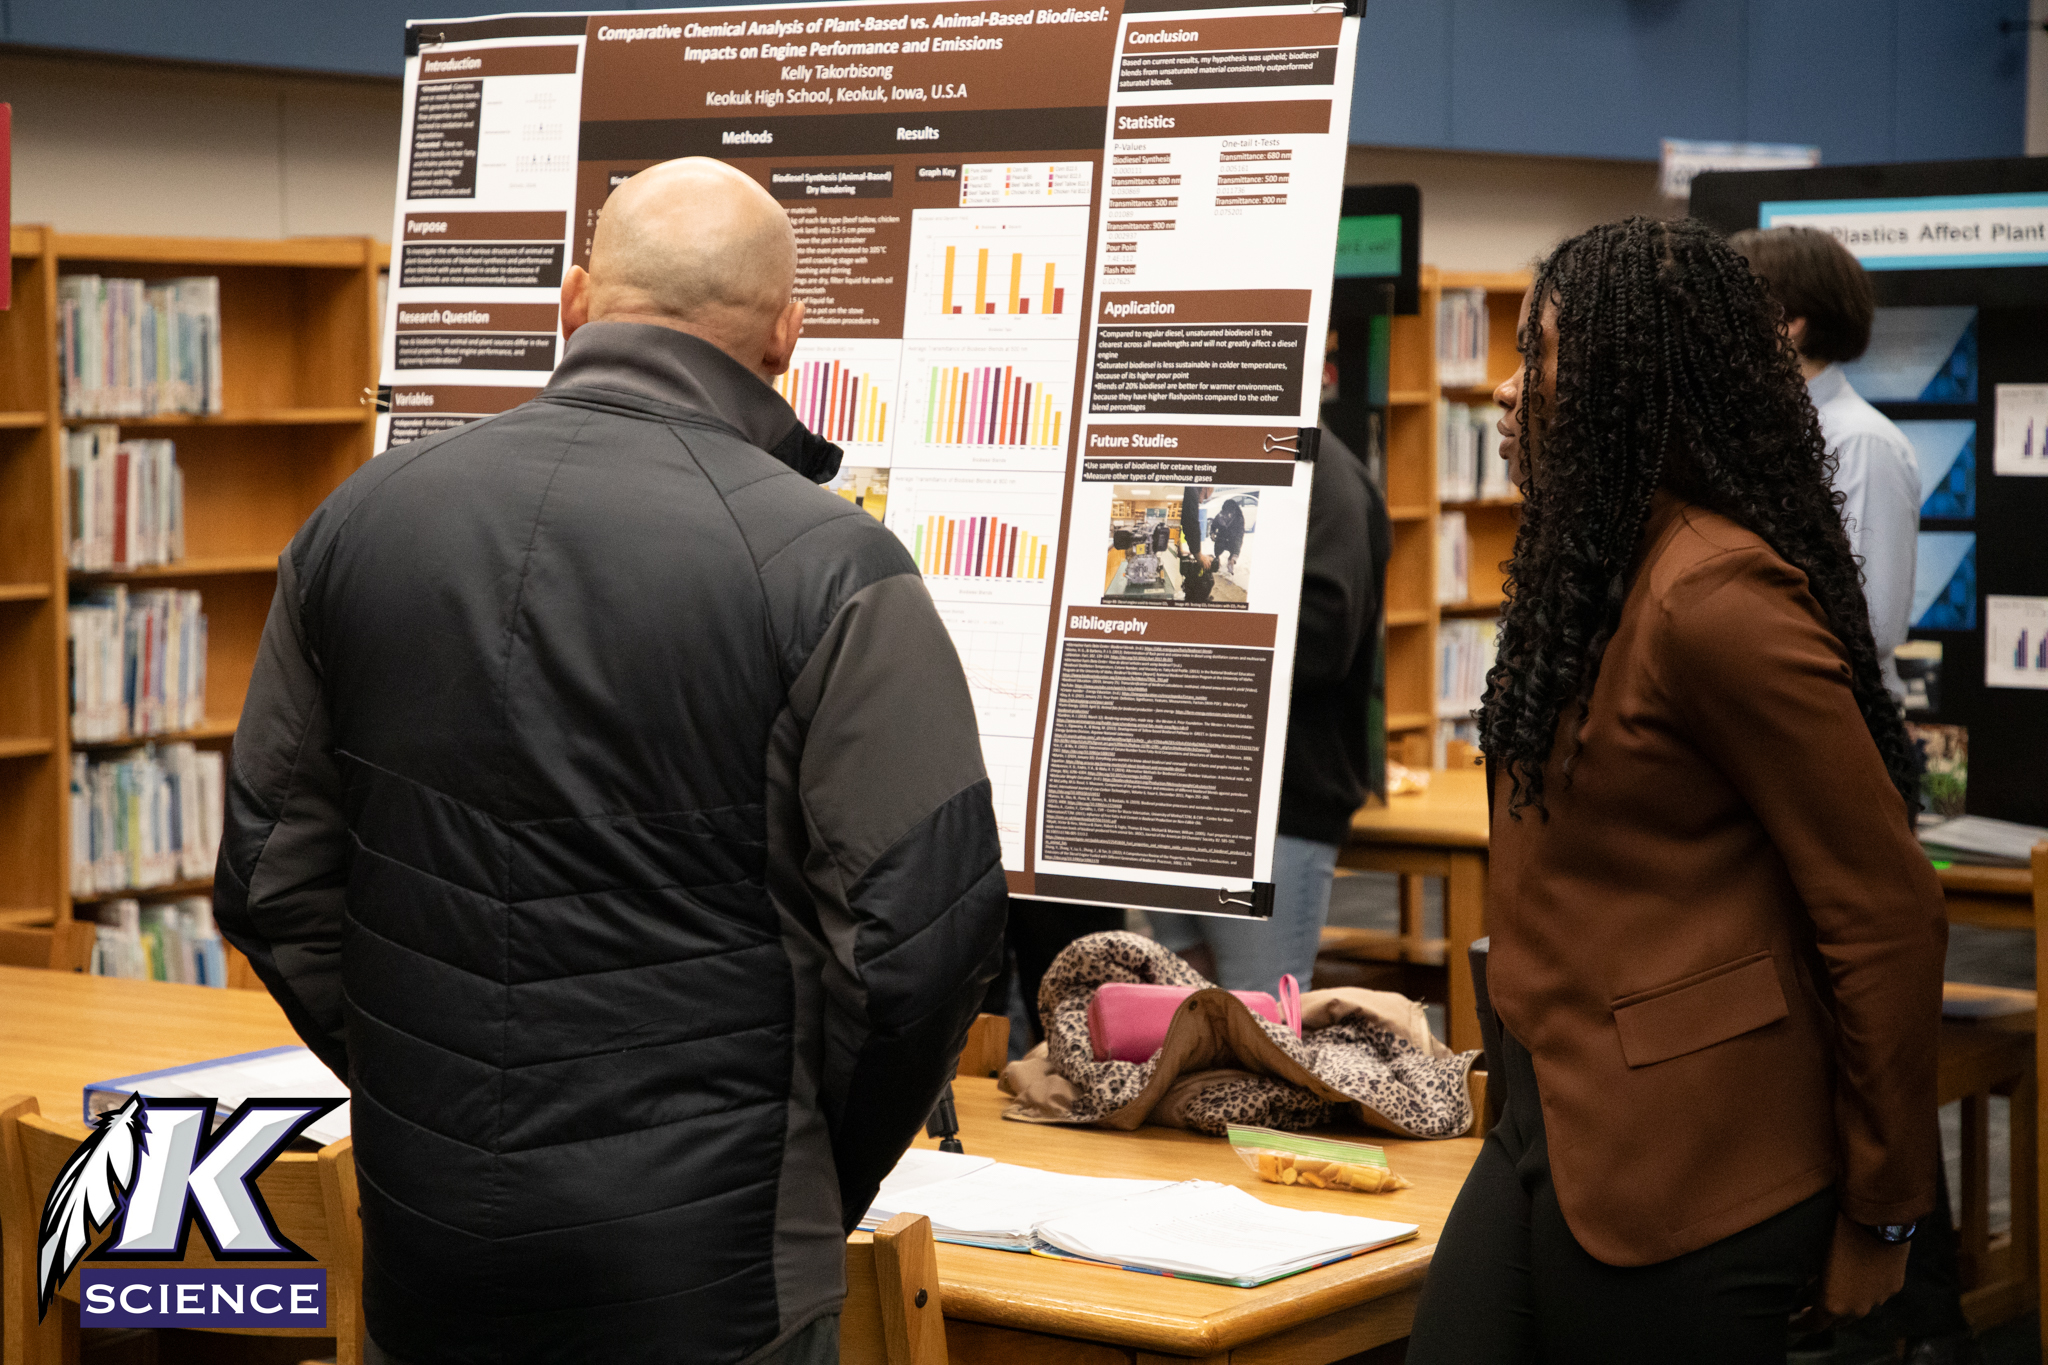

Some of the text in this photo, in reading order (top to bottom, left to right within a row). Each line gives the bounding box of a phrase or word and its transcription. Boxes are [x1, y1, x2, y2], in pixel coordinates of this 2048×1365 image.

[598, 7, 1109, 43] Comparative Chemical Analysis of Plant-Based vs. Animal-Based Biodiesel:
[1129, 29, 1199, 44] Conclusion
[685, 35, 1003, 64] Impacts on Engine Performance and Emissions
[425, 57, 482, 72] Introduction
[1212, 55, 1248, 64] hypothesis
[1262, 53, 1288, 62] upheld;
[782, 64, 894, 83] Kelly Takorbisong
[1160, 67, 1199, 75] unsaturated
[1227, 64, 1266, 74] consistently
[1267, 62, 1314, 72] outperformed
[706, 84, 968, 107] Keokuk High School, Keokuk, Iowa, U.S.A
[1119, 115, 1175, 129] Statistics
[722, 130, 773, 144] Methods
[897, 126, 940, 140] Results
[1113, 155, 1172, 165] Biodiesel Synthesis
[773, 172, 892, 183] Biodiesel Synthesis (Animal-Based)
[919, 168, 956, 178] Graph Key
[820, 185, 856, 196] Rendering
[408, 221, 447, 235] Purpose
[1831, 222, 2046, 243] Plastics Affect Plant
[1105, 301, 1175, 317] Application
[400, 311, 490, 324] Research Question
[1103, 330, 1135, 338] Compared
[1142, 330, 1164, 339] regular
[1152, 340, 1190, 349] wavelengths
[1228, 340, 1251, 348] greatly
[1136, 372, 1156, 380] higher
[396, 393, 434, 406] Variables
[1091, 434, 1178, 448] Future Studies
[1194, 464, 1217, 473] testing
[1088, 473, 1112, 482] Measure
[1113, 473, 1129, 482] other
[1130, 474, 1147, 483] types
[1148, 474, 1155, 483] of
[1155, 474, 1194, 483] greenhouse
[1070, 615, 1147, 635] Bibliography
